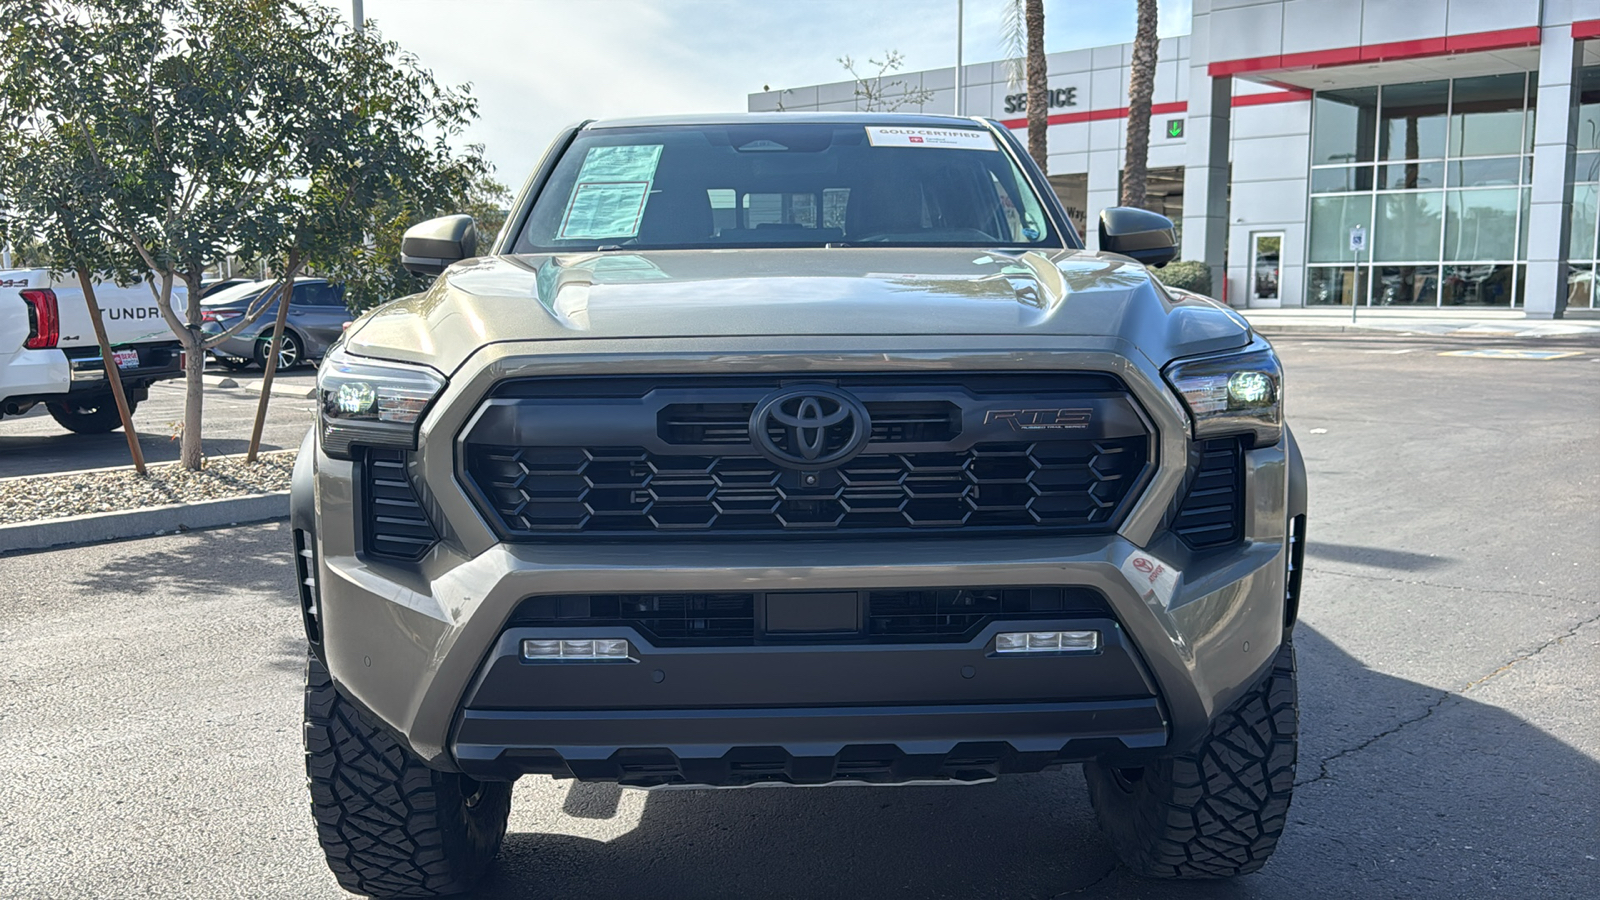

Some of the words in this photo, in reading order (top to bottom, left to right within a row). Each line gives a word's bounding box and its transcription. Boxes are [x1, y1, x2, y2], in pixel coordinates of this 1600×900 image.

[1004, 86, 1077, 114] SEICE
[917, 130, 980, 139] CERTIFIED
[100, 307, 165, 320] TUNDR
[983, 408, 1094, 431] RTS
